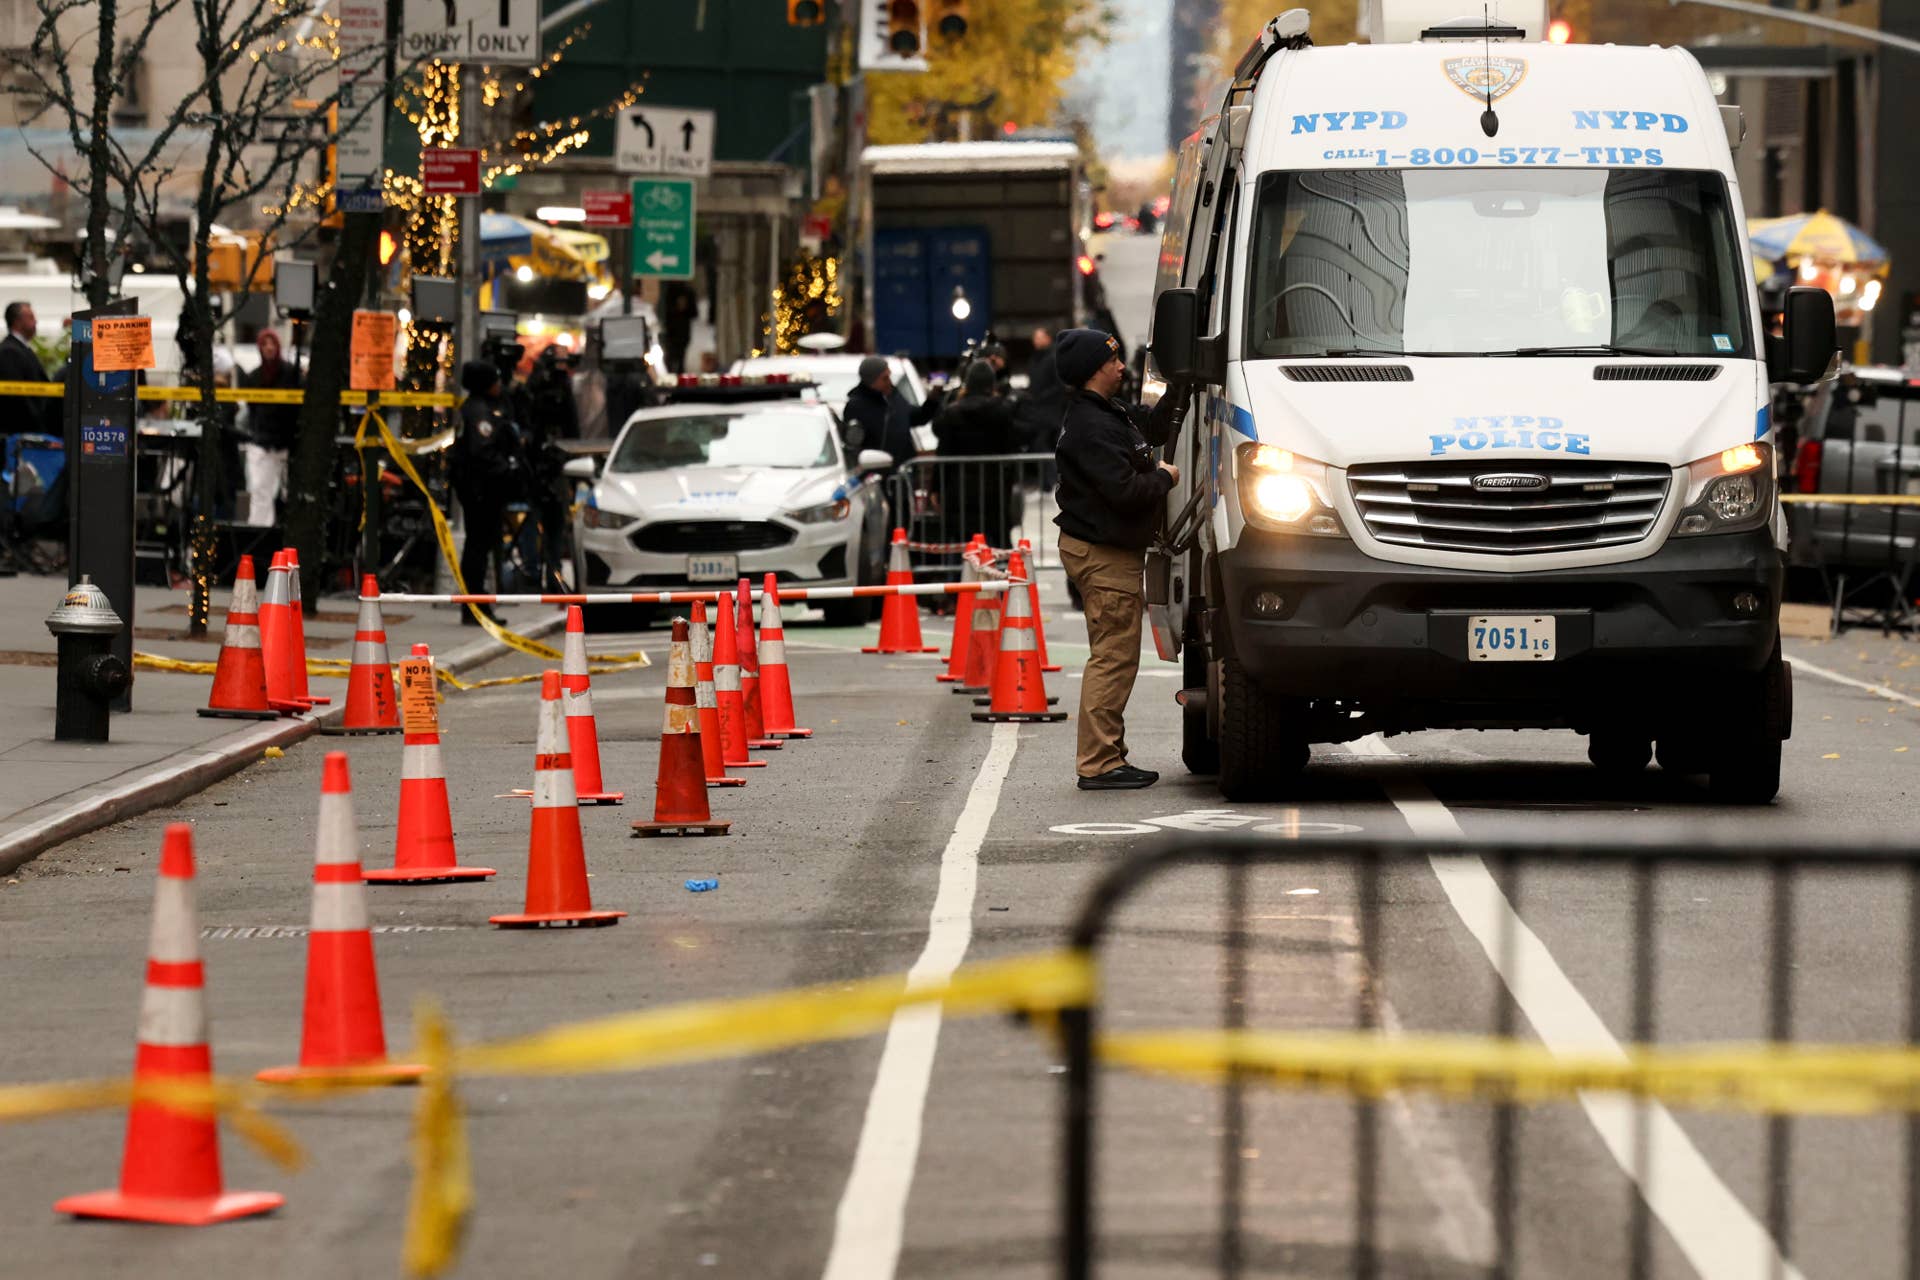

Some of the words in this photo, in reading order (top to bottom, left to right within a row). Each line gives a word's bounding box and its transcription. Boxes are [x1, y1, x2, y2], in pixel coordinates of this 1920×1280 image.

[410, 32, 461, 50] ONLY
[477, 33, 528, 52] ONLY
[1290, 111, 1408, 135] NYPD
[1571, 111, 1689, 133] NYPD
[669, 156, 705, 168] ONLY
[1323, 149, 1373, 160] CALL:
[1376, 147, 1664, 166] 1-800-577-TIPS
[640, 218, 684, 229] Central
[647, 232, 675, 242] Park
[113, 321, 149, 329] PARKING
[1454, 416, 1563, 430] NYPD
[84, 431, 125, 442] 103578
[1429, 430, 1590, 456] POLICE
[1482, 478, 1540, 487] FREIGHTLINER
[1474, 627, 1528, 650] 7051
[1533, 639, 1549, 650] 16
[406, 666, 419, 674] NO
